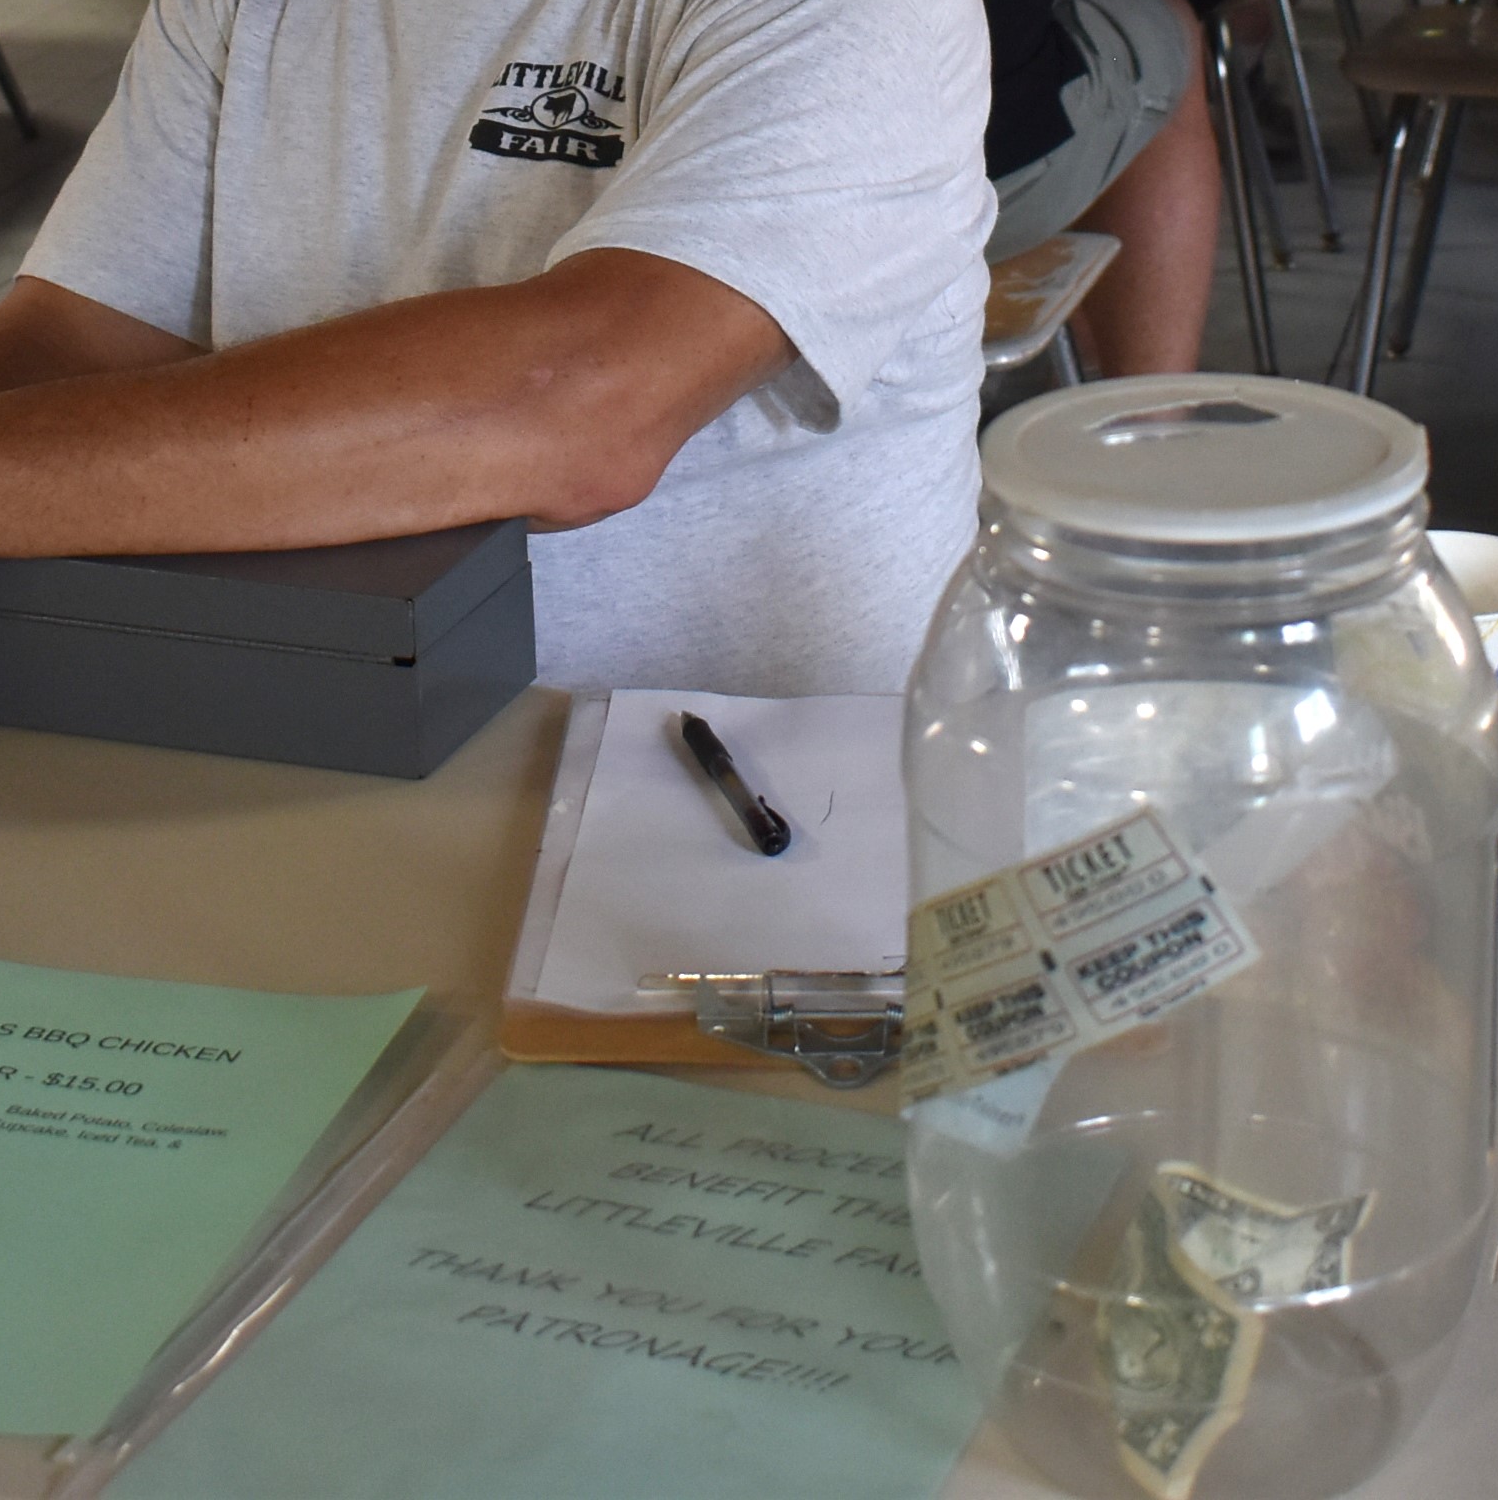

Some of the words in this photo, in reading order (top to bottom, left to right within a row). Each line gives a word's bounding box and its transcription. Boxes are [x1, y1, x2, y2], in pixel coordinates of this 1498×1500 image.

[498, 130, 600, 161] FAIR
[1042, 833, 1133, 893] TICKET
[935, 891, 992, 937] TICKET
[1077, 942, 1138, 980] KEEP
[1144, 910, 1206, 946] THIS
[1095, 930, 1205, 994] COUPON
[22, 1025, 91, 1049] BBQ
[98, 1035, 243, 1064] CHICKEN
[6, 1103, 68, 1121] Baked
[41, 1071, 144, 1096] $15.00
[76, 1129, 120, 1144] Iced
[166, 1138, 182, 1150] &
[611, 1122, 704, 1149] ALL
[719, 1138, 907, 1181] PROCEE
[522, 1190, 833, 1259] LITTLEVILLE
[607, 1162, 826, 1207] BENEFIT
[831, 1195, 913, 1228] THE
[408, 1248, 582, 1293] THANK
[595, 1282, 704, 1315] YOU
[708, 1306, 820, 1338] FOR
